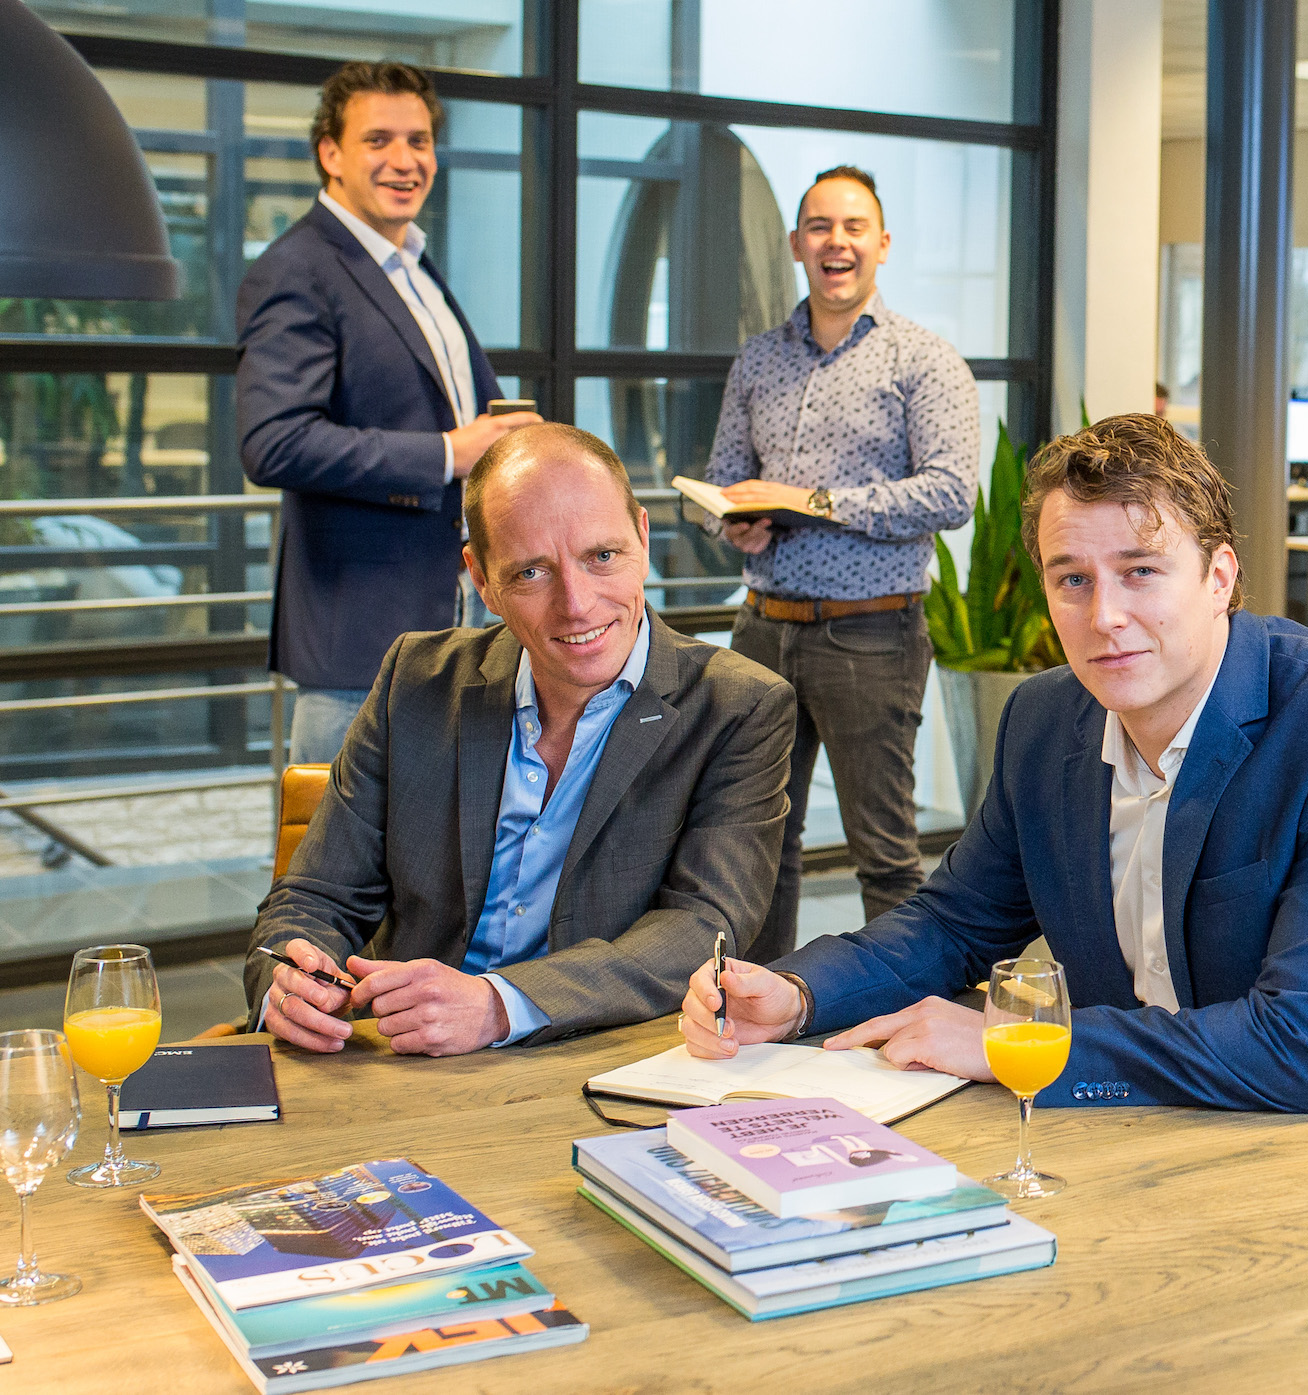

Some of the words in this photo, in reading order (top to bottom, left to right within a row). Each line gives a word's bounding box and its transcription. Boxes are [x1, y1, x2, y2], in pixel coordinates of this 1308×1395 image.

[710, 1108, 836, 1127] VERBERGEN
[718, 1124, 747, 1133] TE
[730, 1126, 784, 1140] HEBT
[297, 1232, 513, 1288] LOCUS
